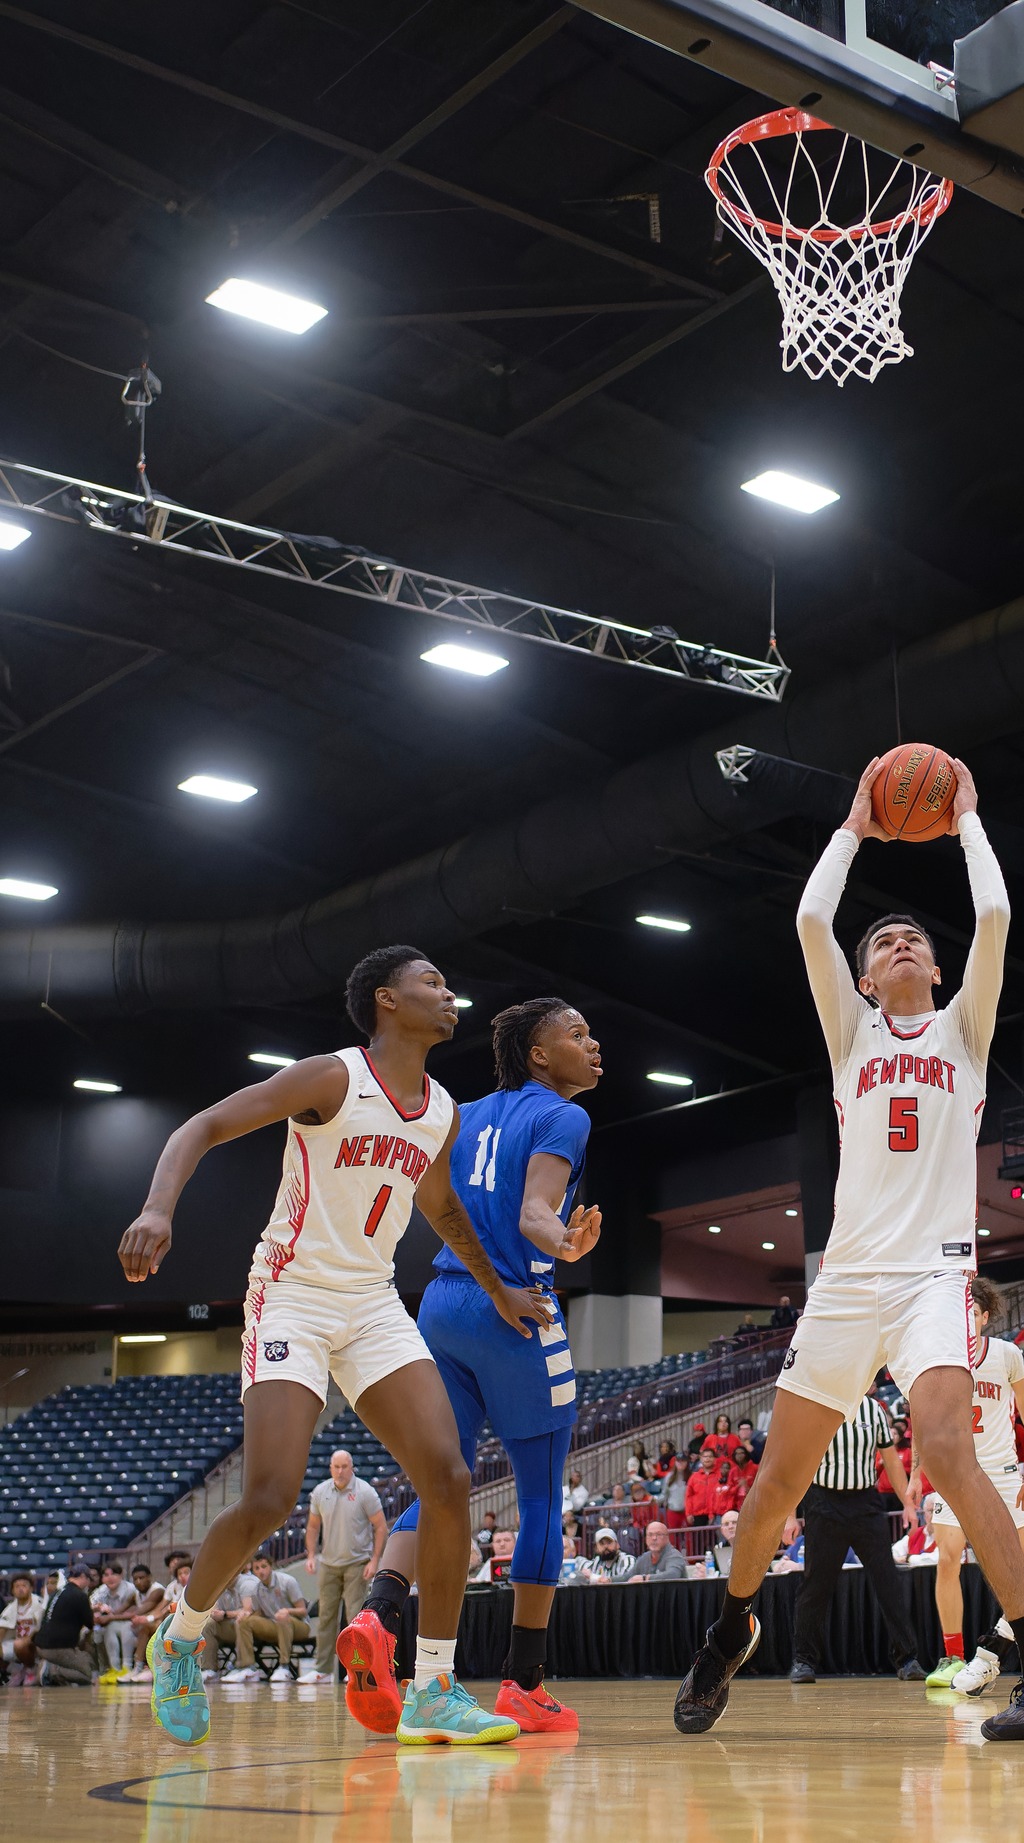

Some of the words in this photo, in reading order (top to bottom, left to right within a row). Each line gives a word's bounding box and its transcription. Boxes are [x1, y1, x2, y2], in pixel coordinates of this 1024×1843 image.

[892, 748, 930, 809] SPALDING
[856, 1053, 956, 1099] NEWPORT
[888, 1097, 919, 1152] 5
[334, 1134, 431, 1185] NEWPOR
[468, 1124, 502, 1192] 11
[364, 1184, 393, 1238] 1
[188, 1304, 209, 1320] 102
[975, 1381, 1002, 1401] ORT
